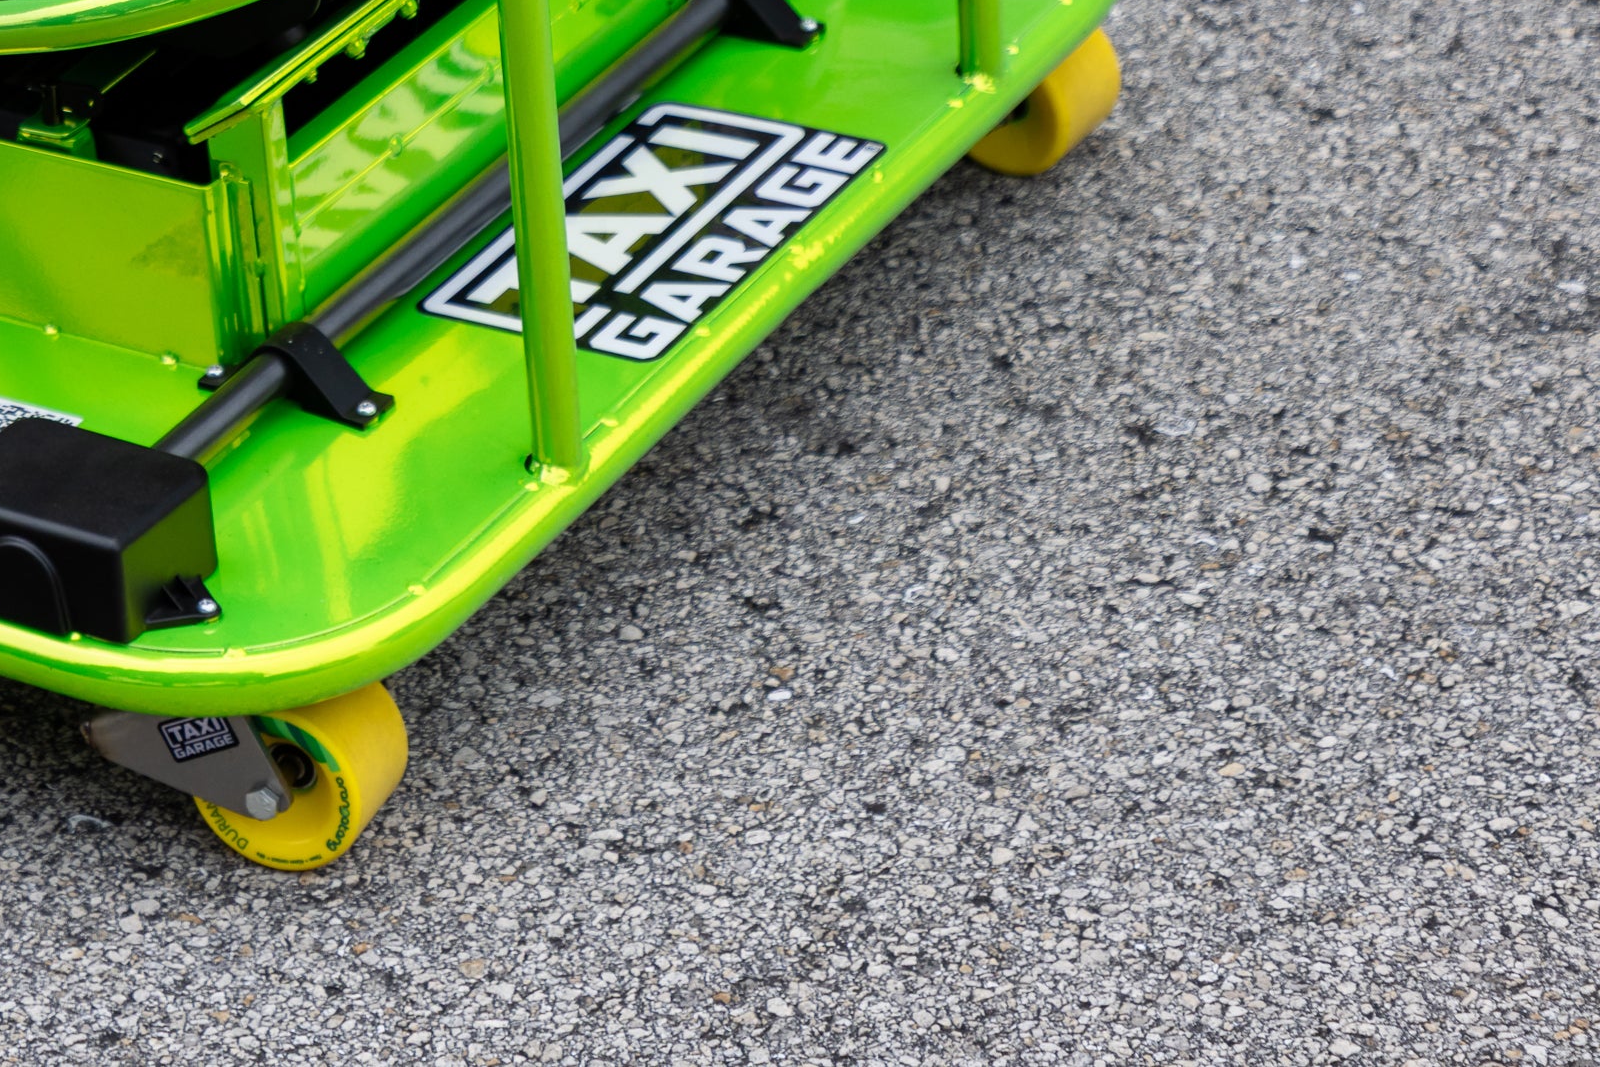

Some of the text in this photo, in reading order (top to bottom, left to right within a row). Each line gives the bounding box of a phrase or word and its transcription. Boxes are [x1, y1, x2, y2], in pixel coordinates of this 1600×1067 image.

[588, 131, 885, 360] GARAGE
[167, 717, 222, 742] TAXI
[174, 733, 235, 759] GARAGE
